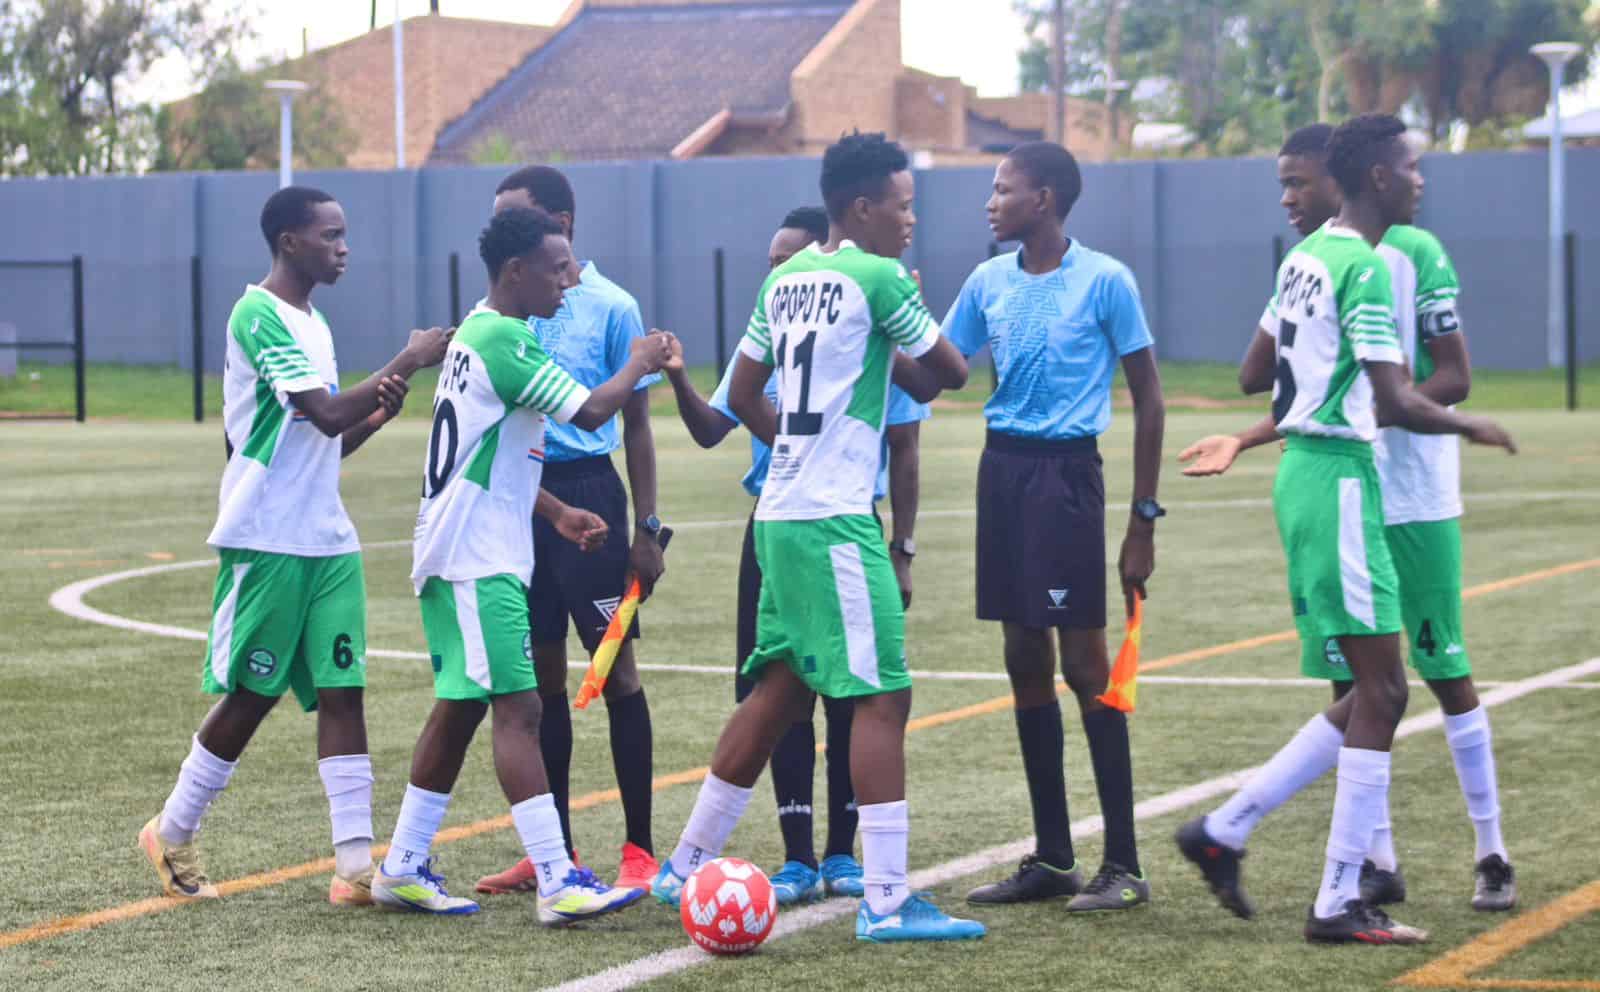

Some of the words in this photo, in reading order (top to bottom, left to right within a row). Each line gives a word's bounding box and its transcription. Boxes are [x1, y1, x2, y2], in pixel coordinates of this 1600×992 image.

[771, 282, 816, 325] OPOPO
[815, 282, 843, 325] FC
[1299, 272, 1322, 317] FC
[1435, 310, 1458, 333] C
[450, 351, 470, 394] FC
[773, 330, 824, 436] 11
[422, 396, 459, 499] 0
[333, 632, 353, 670] 6
[1417, 618, 1436, 657] 4
